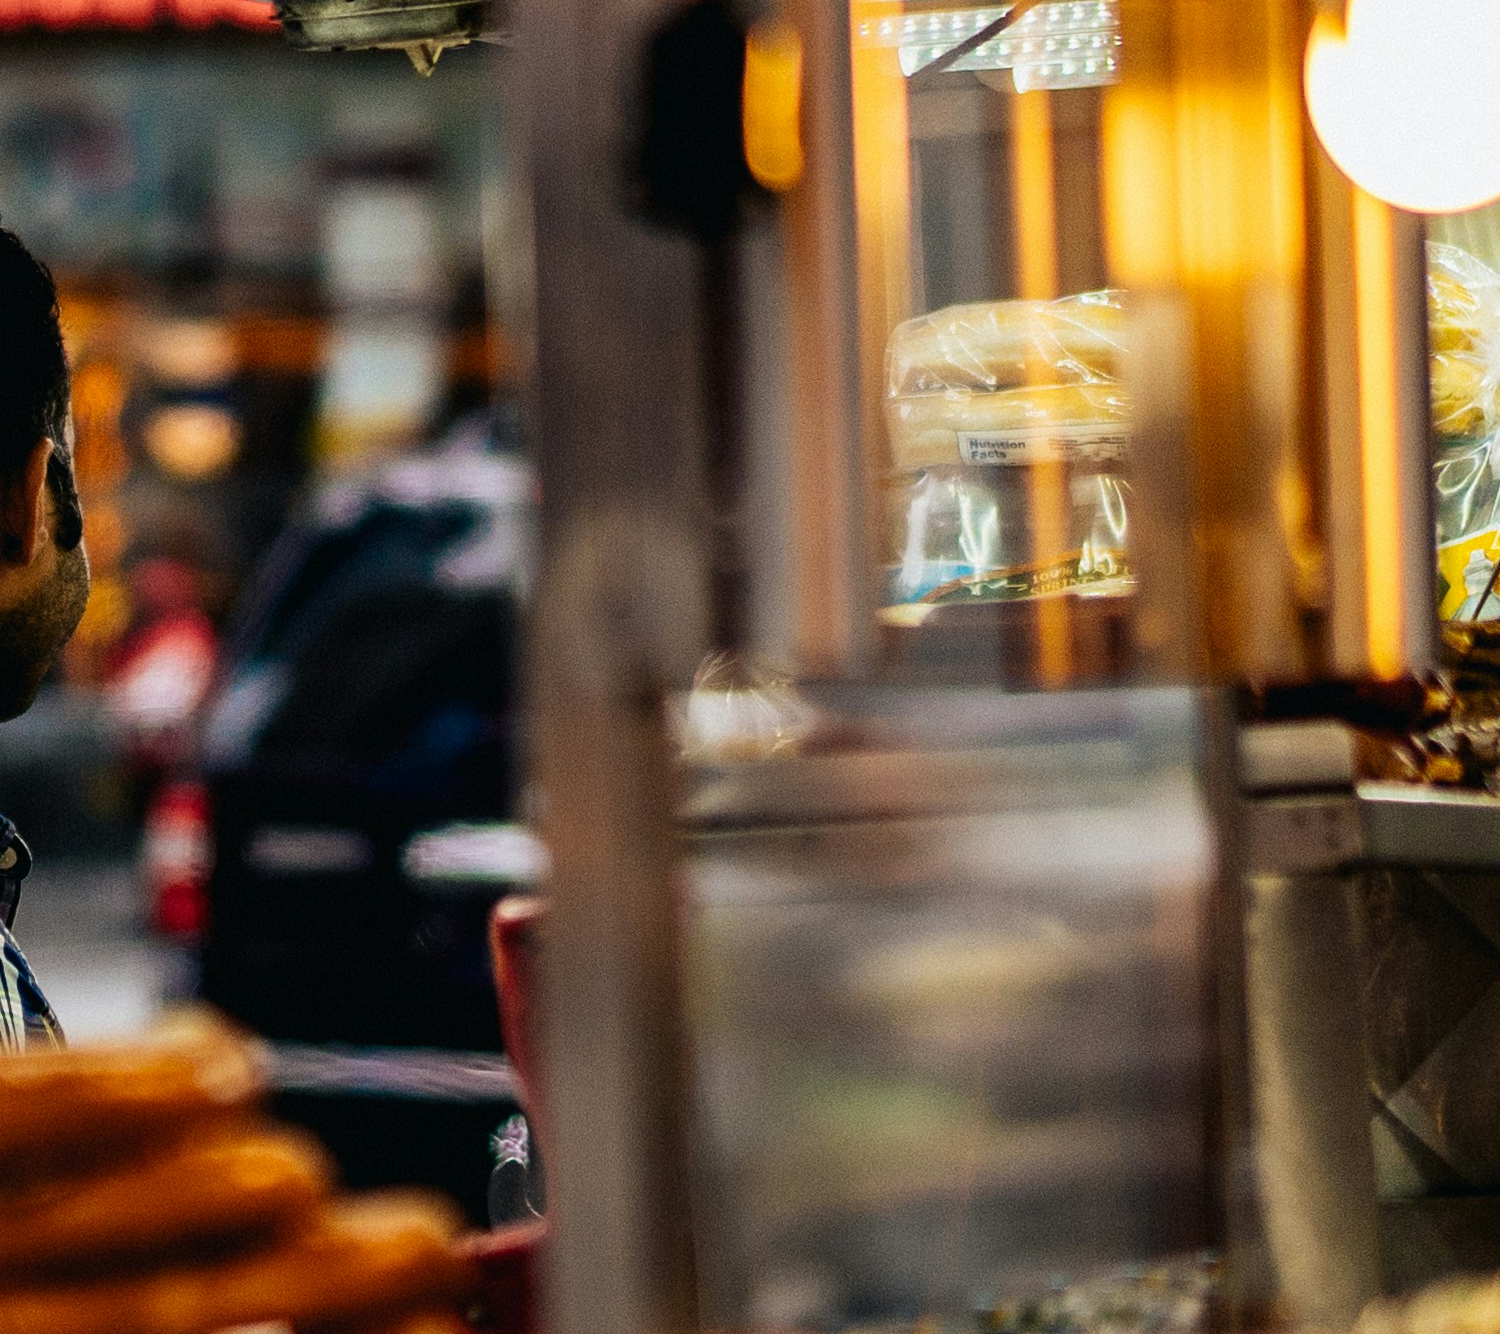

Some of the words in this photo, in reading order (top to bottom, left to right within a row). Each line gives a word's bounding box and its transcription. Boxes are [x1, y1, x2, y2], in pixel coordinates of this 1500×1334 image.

[969, 439, 1026, 450] Nutrition
[970, 450, 1007, 460] Facts
[1032, 568, 1073, 585] 100%
